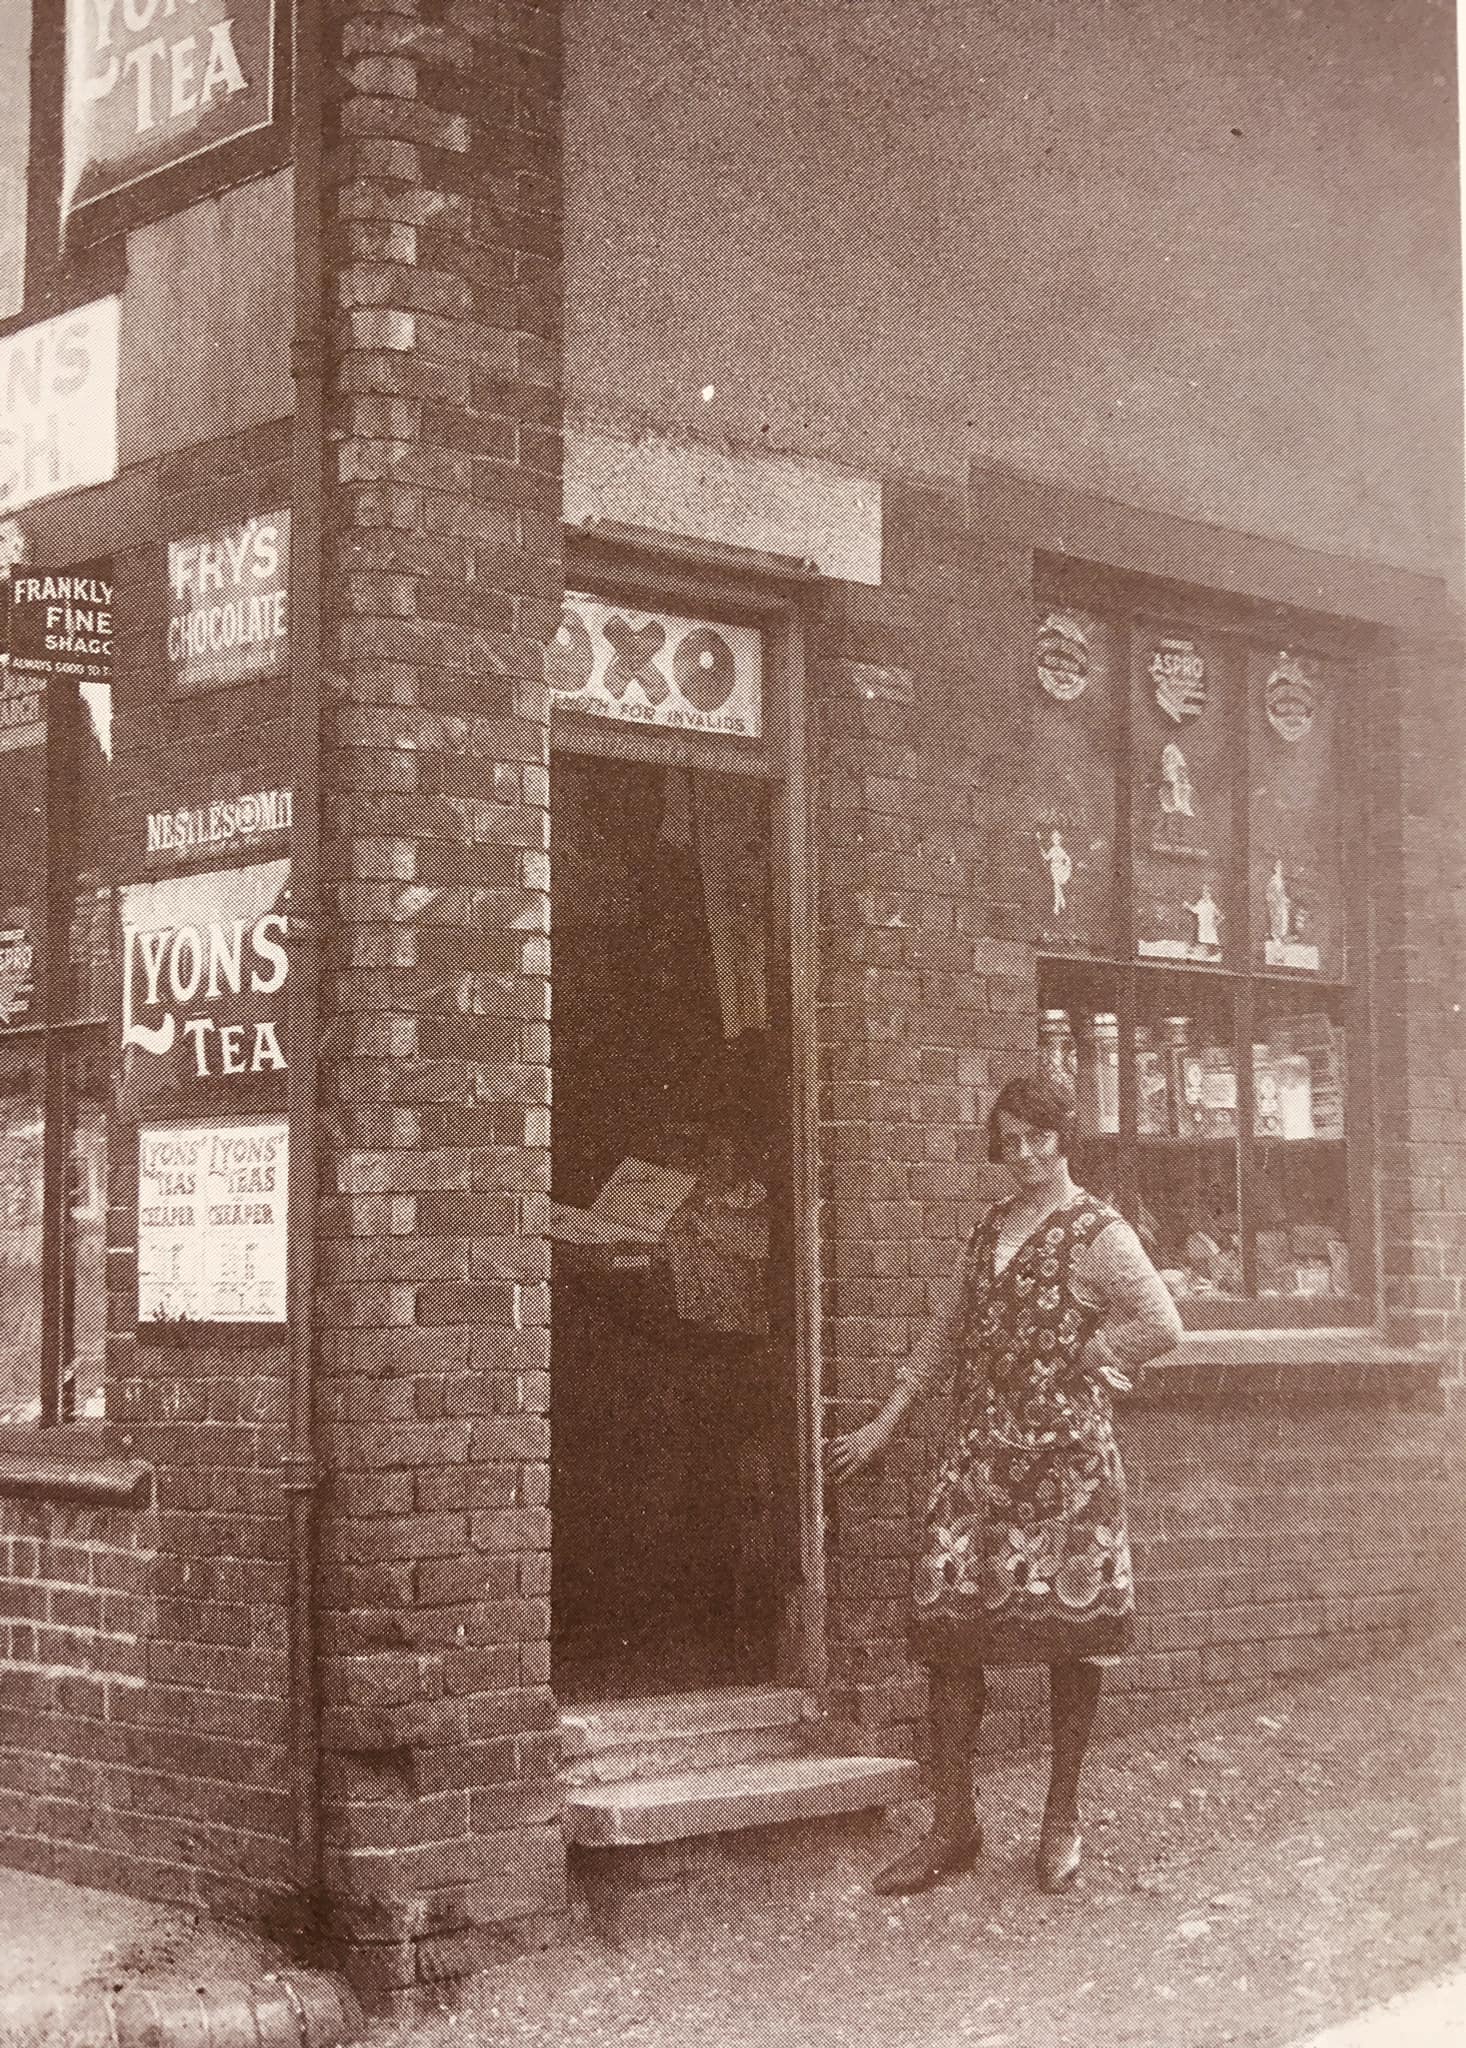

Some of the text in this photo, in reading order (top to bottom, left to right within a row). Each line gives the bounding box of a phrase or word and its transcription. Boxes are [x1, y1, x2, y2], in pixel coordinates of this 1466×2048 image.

[124, 18, 249, 134] TEA
[46, 606, 113, 634] FINE
[167, 589, 288, 662] CHOCOLATE
[13, 658, 52, 672] ALWAYS
[55, 661, 84, 674] GOOD
[546, 607, 736, 712] OXO
[621, 702, 656, 720] FOR
[667, 709, 746, 732] INVALIDS
[184, 1018, 289, 1077] TEA
[158, 1170, 196, 1196] TEAS
[227, 1166, 275, 1194] TEAS
